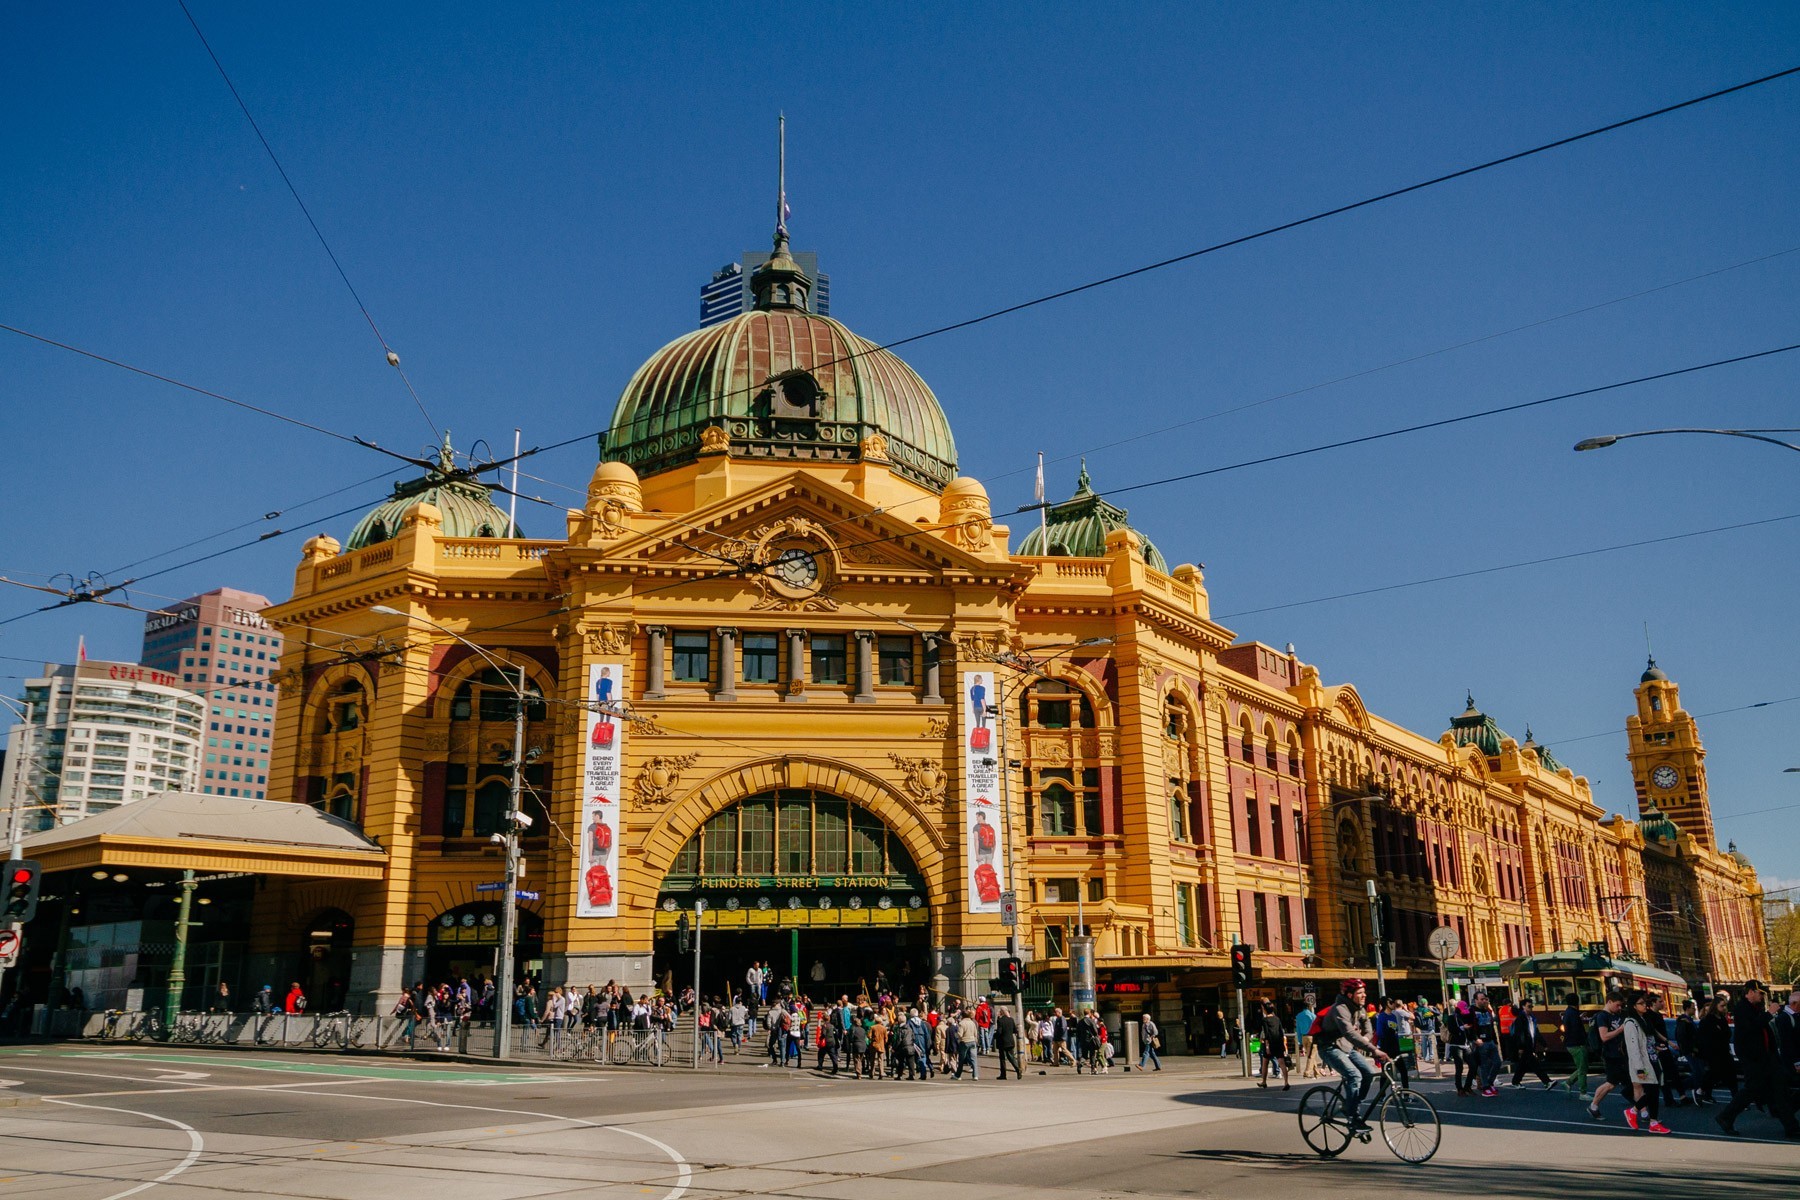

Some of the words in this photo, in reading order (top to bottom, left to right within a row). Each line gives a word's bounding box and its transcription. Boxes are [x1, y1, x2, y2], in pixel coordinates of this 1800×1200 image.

[144, 616, 178, 633] HERALD
[180, 607, 198, 621] SUN
[110, 665, 144, 681] QUAY
[151, 672, 176, 687] WEST
[701, 878, 761, 889] FLINDERS
[776, 877, 821, 888] STREET
[834, 877, 888, 888] STATION
[1591, 943, 1606, 955] 35
